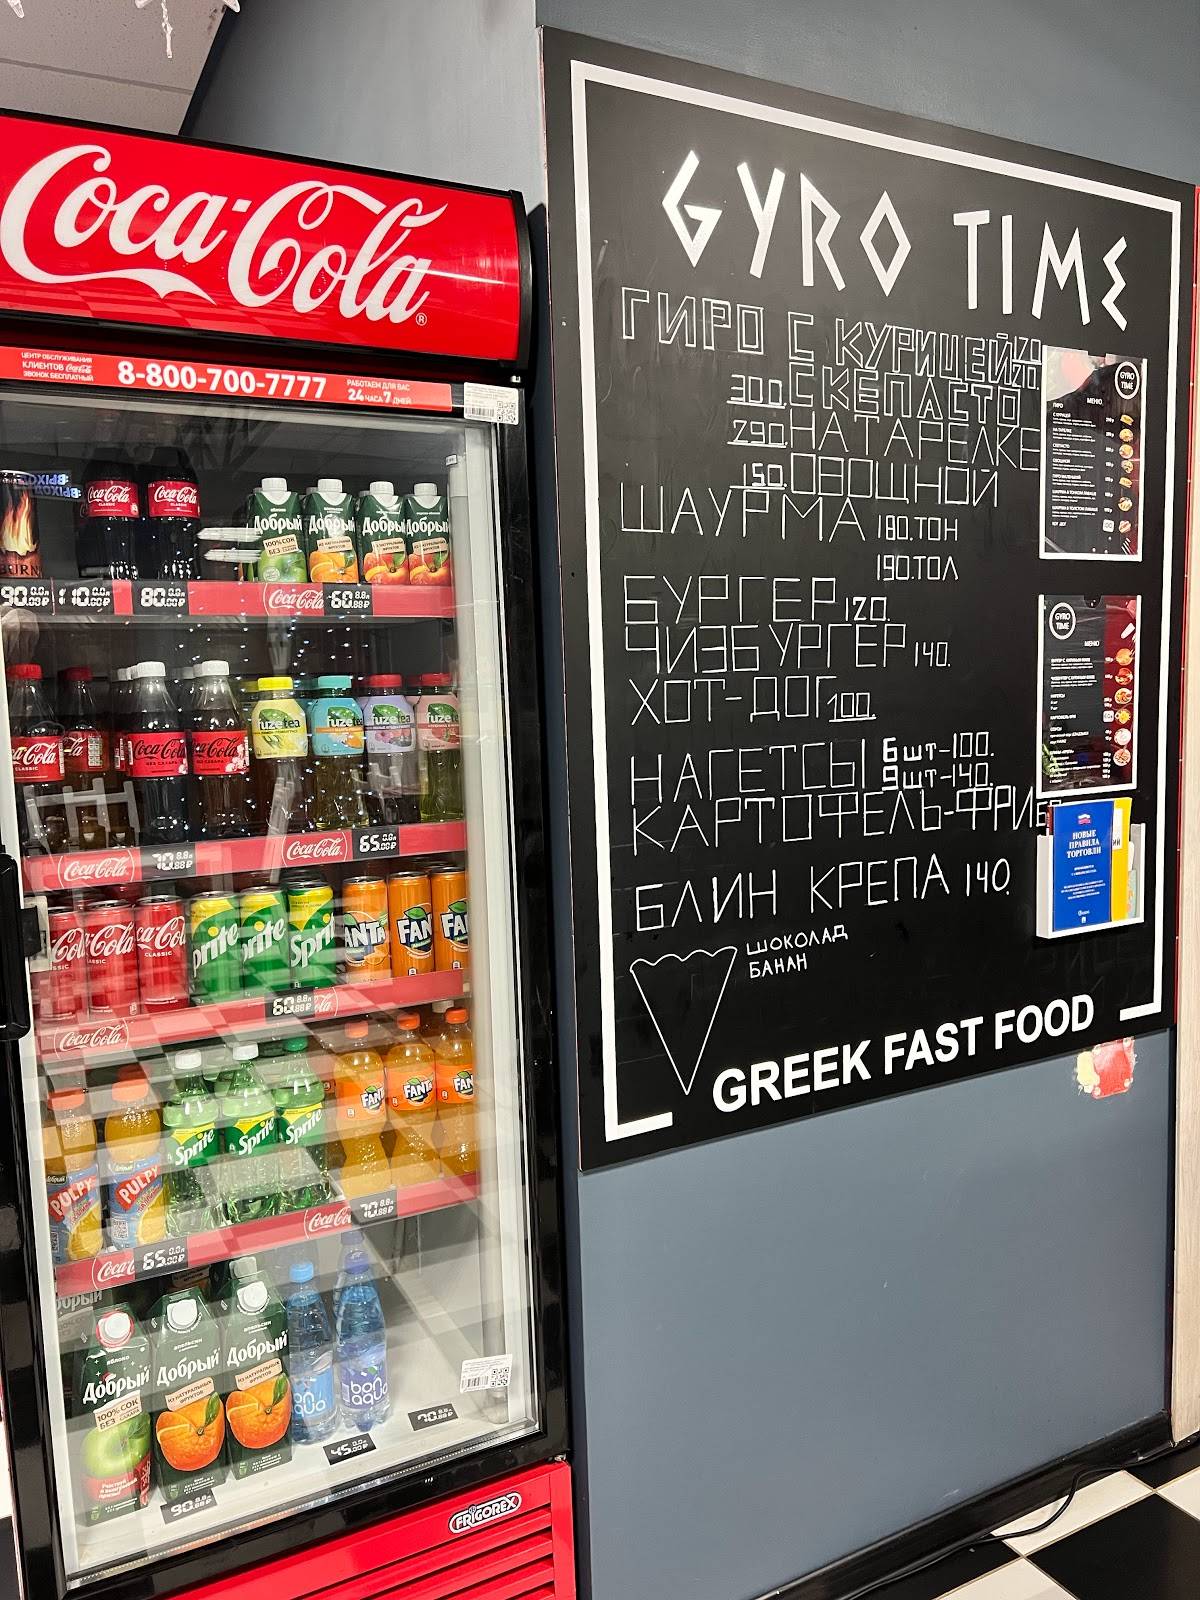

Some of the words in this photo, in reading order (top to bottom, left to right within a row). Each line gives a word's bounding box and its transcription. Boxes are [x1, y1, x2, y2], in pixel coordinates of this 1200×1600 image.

[1, 145, 448, 324] Coca-Cola
[662, 150, 912, 297] GYRO
[953, 210, 1128, 331] TIME
[622, 286, 764, 355] ГИРО
[788, 311, 814, 362] С
[835, 317, 1015, 386] КУРИЦЕЙ
[22, 361, 64, 371] КЛИЕНТОВ
[117, 360, 328, 400] 8-800-700-7777
[1120, 372, 1135, 380] GYRO
[346, 379, 381, 389] РАБОТАЕМ
[381, 382, 397, 391] ДЛЯ
[397, 383, 410, 392] ВАС
[348, 388, 365, 402] 24
[365, 395, 383, 403] ЧАСА
[383, 392, 391, 404] 7
[789, 362, 1022, 427] СКЕПАСТО
[1121, 382, 1134, 390] TIME
[88, 485, 131, 503] Coca-Cola
[154, 485, 197, 504] Coca-Cola
[790, 452, 999, 507] ОВОЩНОЙ
[254, 513, 303, 535] Добрый
[620, 481, 865, 542] ШАУРМА
[624, 574, 836, 624] БУРГЕР
[1056, 622, 1070, 630] TIME
[629, 675, 837, 725] ХОТ-ДОГ
[631, 738, 866, 805] НАГЕТСЫ
[633, 784, 1034, 856] КАРТОФЕЛЬ-ФРИ
[1072, 829, 1097, 840] НОВЫЕ
[286, 838, 342, 860] Coca-Cola
[1066, 847, 1102, 859] ТОРГОВЛИ
[1069, 838, 1100, 849] ПРАВИЛА
[63, 856, 130, 883] Coca-Cola
[636, 870, 776, 932] БЛИН
[811, 853, 950, 913] КРЕПА
[290, 912, 335, 968] Sprit
[344, 921, 386, 948] ANTA
[397, 914, 432, 944] FAN
[746, 926, 848, 956] ШОКОЛАД
[192, 923, 240, 978] prite
[749, 953, 808, 979] БАНАН
[60, 1024, 122, 1052] Coca-Cola
[713, 1040, 872, 1113] GREEK
[884, 1017, 984, 1076] FAST
[994, 993, 1095, 1050] FOOD
[361, 1087, 385, 1109] FANT
[404, 1080, 433, 1100] FANTA
[453, 1075, 473, 1093] FAN
[285, 1109, 322, 1145] Sprite
[175, 1129, 215, 1166] Sprite
[50, 1178, 93, 1217] PULPY
[118, 1164, 159, 1204] PULPY
[226, 1329, 289, 1367] Добрый
[157, 1348, 220, 1387] Добрый
[83, 1365, 151, 1404] Добрый
[294, 1391, 314, 1404] on
[96, 1407, 120, 1422] 100%
[120, 1398, 138, 1411] СОК
[100, 1418, 116, 1430] БЕЗ
[294, 1400, 326, 1418] qua
[454, 1494, 518, 1527] FRIGOREX
